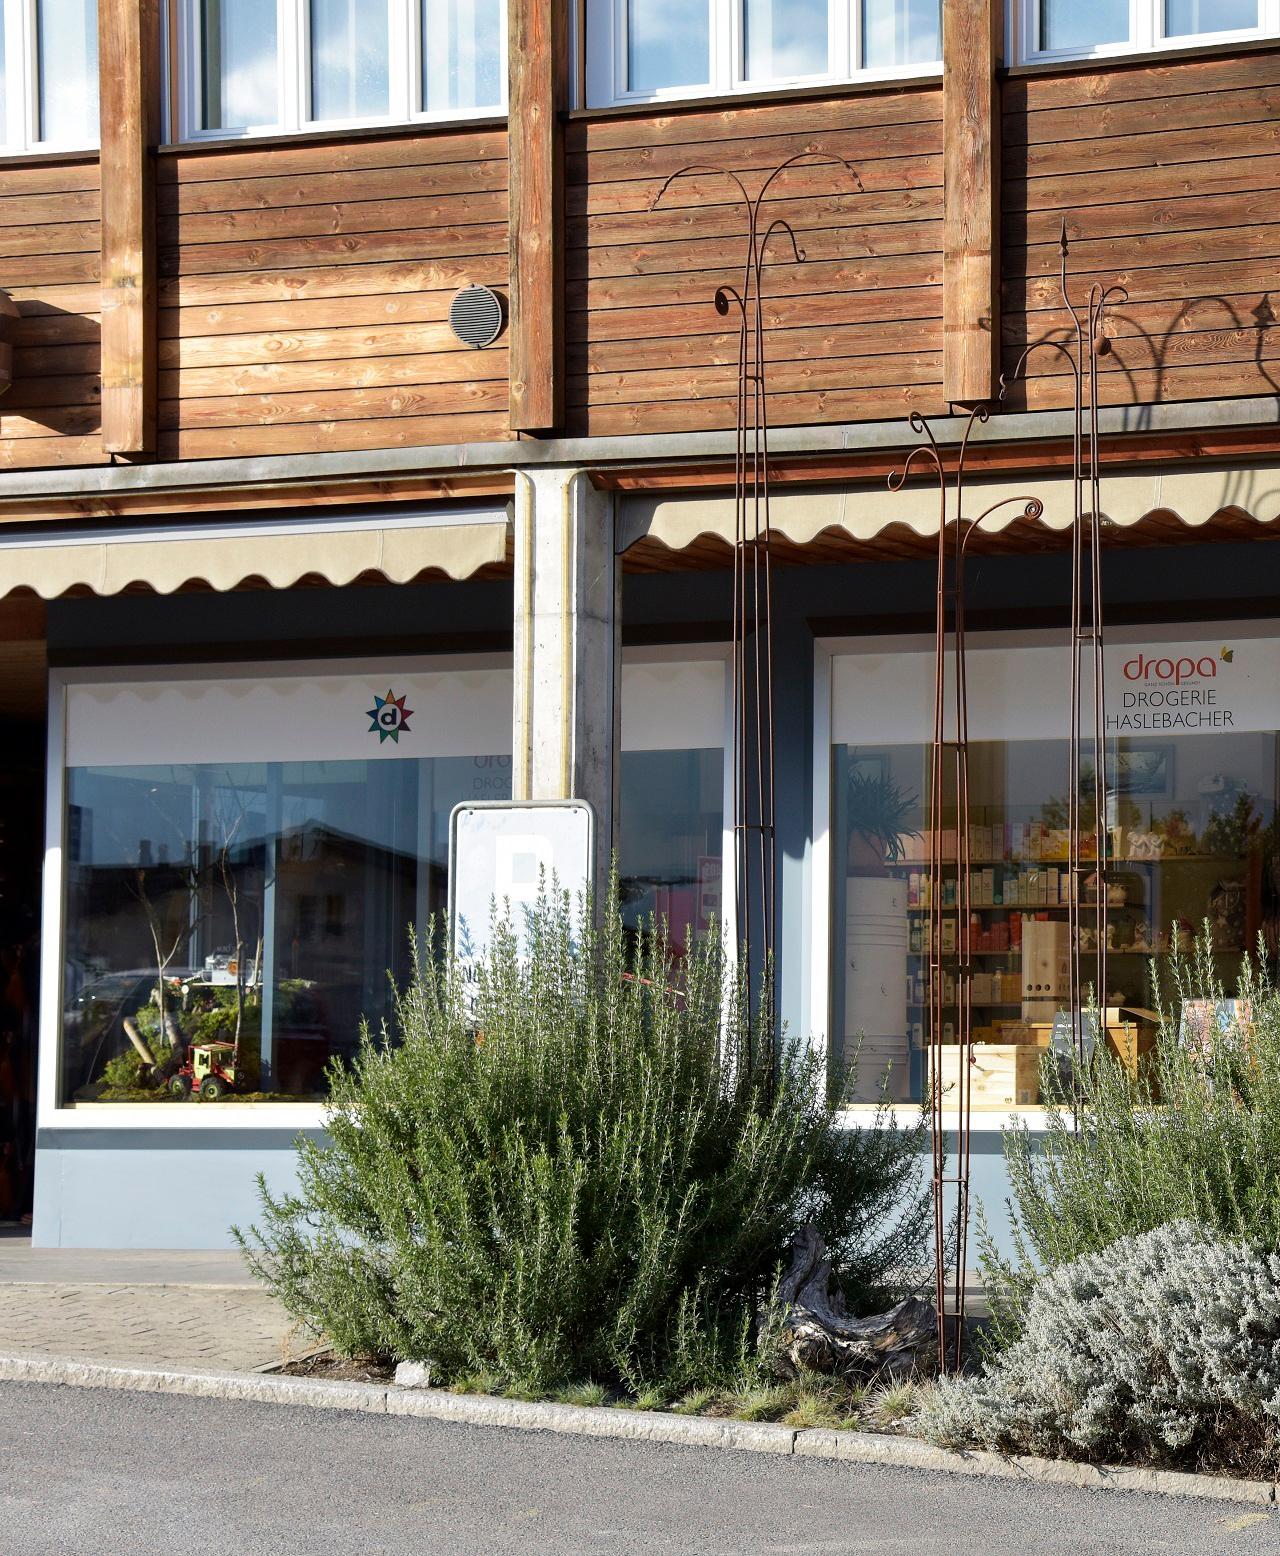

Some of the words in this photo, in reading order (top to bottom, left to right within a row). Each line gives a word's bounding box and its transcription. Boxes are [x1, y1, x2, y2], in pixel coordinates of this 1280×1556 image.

[1123, 654, 1217, 685] dropa
[1123, 690, 1216, 708] DROGERIE
[380, 708, 397, 726] d
[1106, 711, 1234, 730] HASLEBACHER
